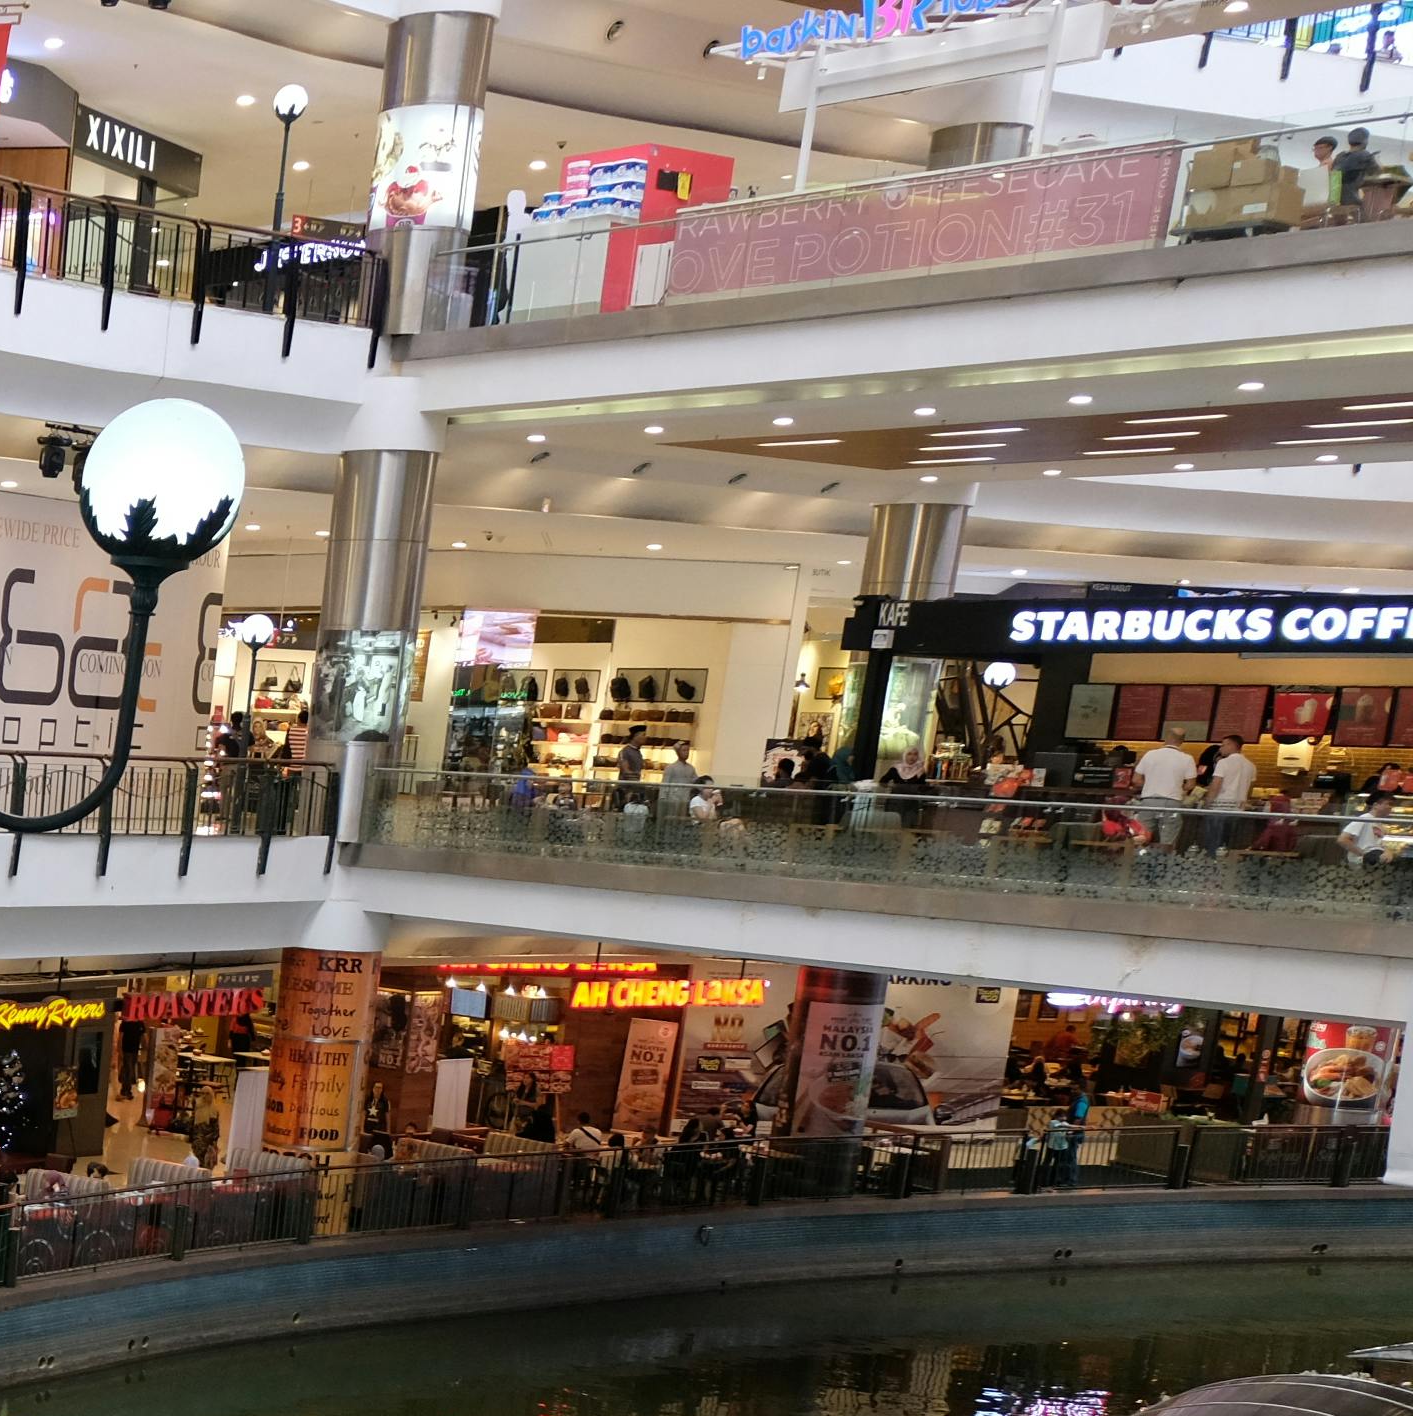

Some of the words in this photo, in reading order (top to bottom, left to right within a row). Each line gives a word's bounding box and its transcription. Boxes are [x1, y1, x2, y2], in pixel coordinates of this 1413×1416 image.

[85, 113, 157, 173] XIXILI
[42, 525, 82, 549] PRICE
[878, 601, 911, 628] KAFE
[1008, 606, 1274, 644] STARBUCKS
[1280, 606, 1413, 642] COFF
[316, 956, 363, 974] KRR
[124, 987, 265, 1022] ROASTERS
[570, 980, 611, 1009] AH
[611, 979, 691, 1008] CHENG
[45, 998, 106, 1029] Rogers
[299, 1001, 357, 1020] Together
[312, 1025, 351, 1038] LOVE
[819, 1033, 872, 1052] NO.1
[288, 1048, 350, 1067] HEALTHY
[629, 1050, 665, 1064] NO.1
[291, 1073, 346, 1099] Family
[298, 1127, 340, 1142] FOOD
